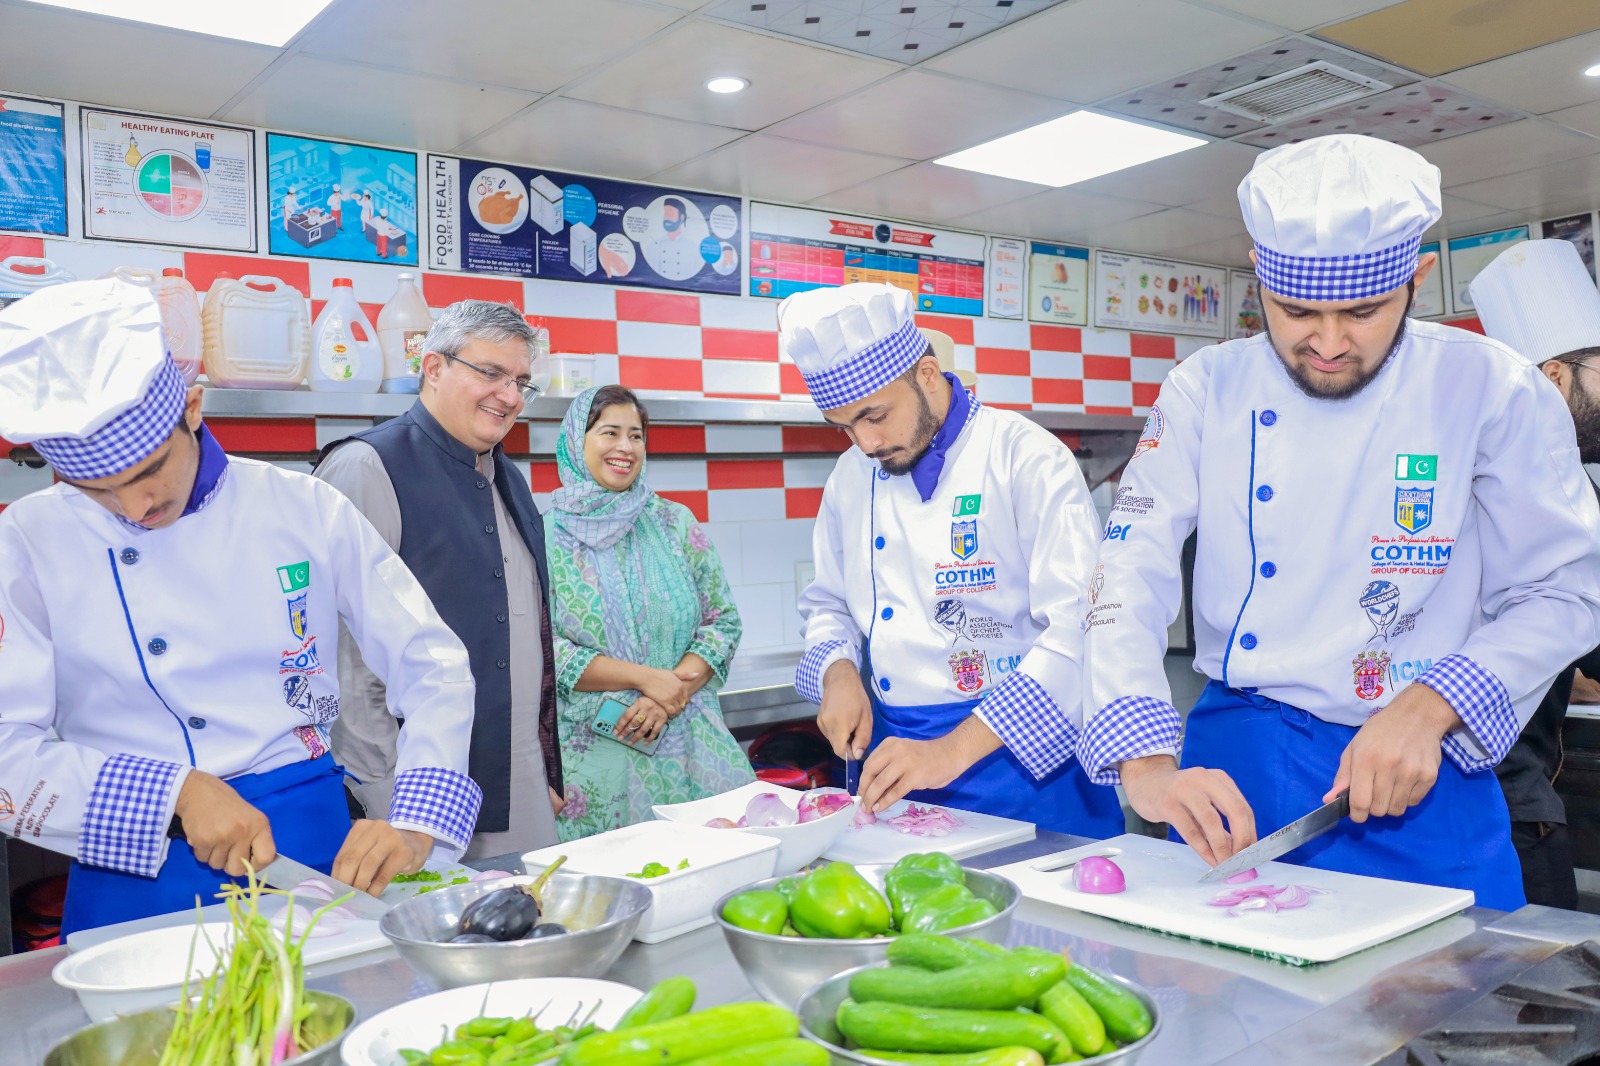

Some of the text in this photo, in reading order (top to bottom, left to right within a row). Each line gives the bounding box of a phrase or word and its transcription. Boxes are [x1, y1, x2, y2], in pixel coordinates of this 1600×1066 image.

[122, 122, 215, 140] HEALTHY EATING PLATE
[436, 160, 447, 266] FOOD HEALTH
[598, 202, 624, 210] PERSONAL
[1120, 506, 1147, 514] SOCIETIES
[1371, 545, 1452, 561] COTHM
[935, 567, 995, 584] COTHM
[966, 584, 996, 593] COLLEGES
[1361, 589, 1399, 607] WORLDCHEFS
[988, 655, 1021, 675] ICM
[20, 779, 46, 815] FEDERATION
